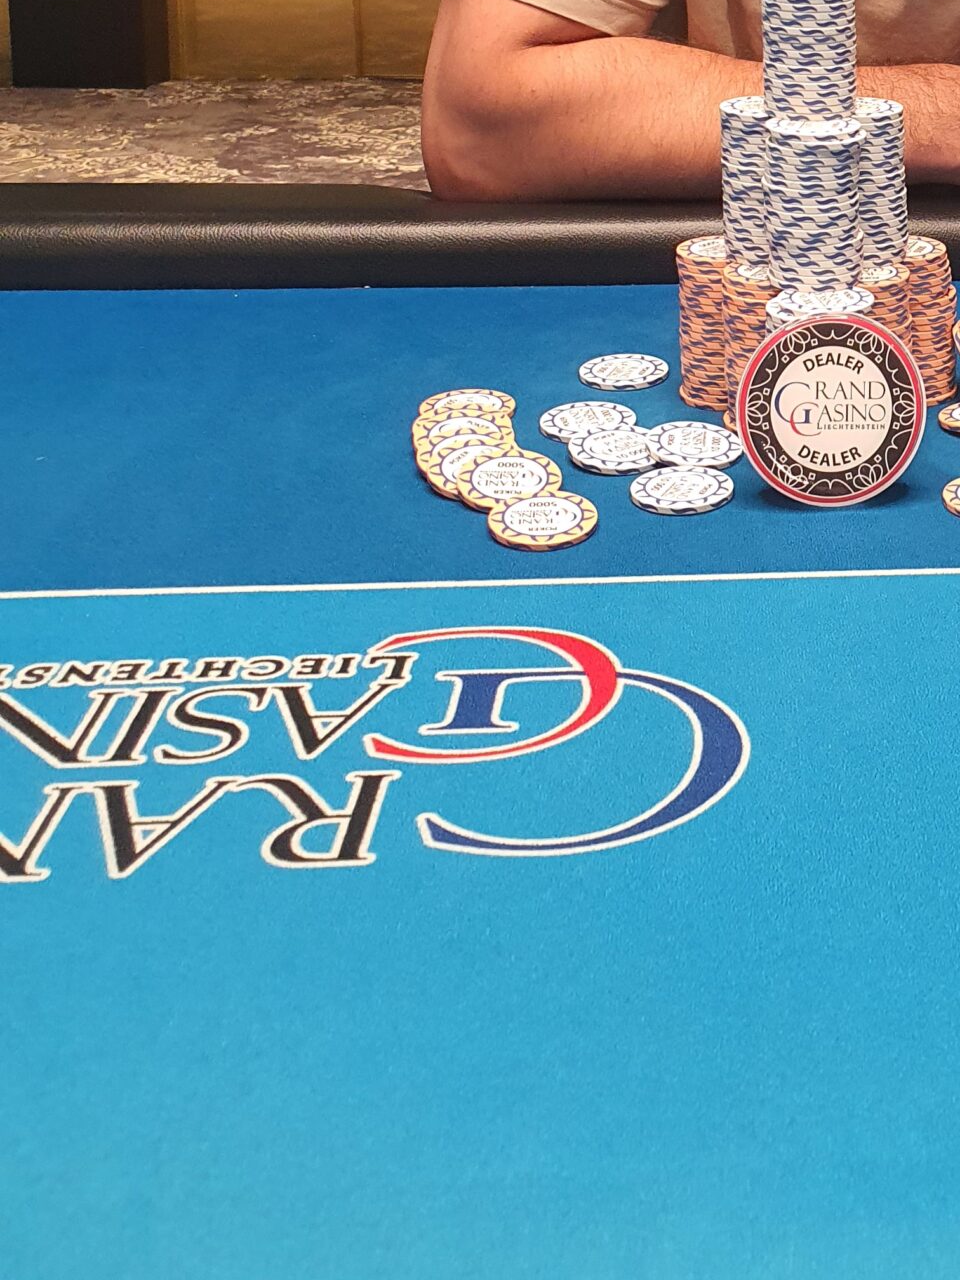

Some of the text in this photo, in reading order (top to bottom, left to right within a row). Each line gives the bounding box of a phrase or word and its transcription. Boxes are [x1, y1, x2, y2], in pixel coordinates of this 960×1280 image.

[802, 352, 864, 375] DEALER
[774, 381, 886, 424] GRAND
[790, 401, 886, 436] CASINO
[816, 422, 886, 431] LIECHTENSTEIN
[797, 444, 862, 467] DEALER
